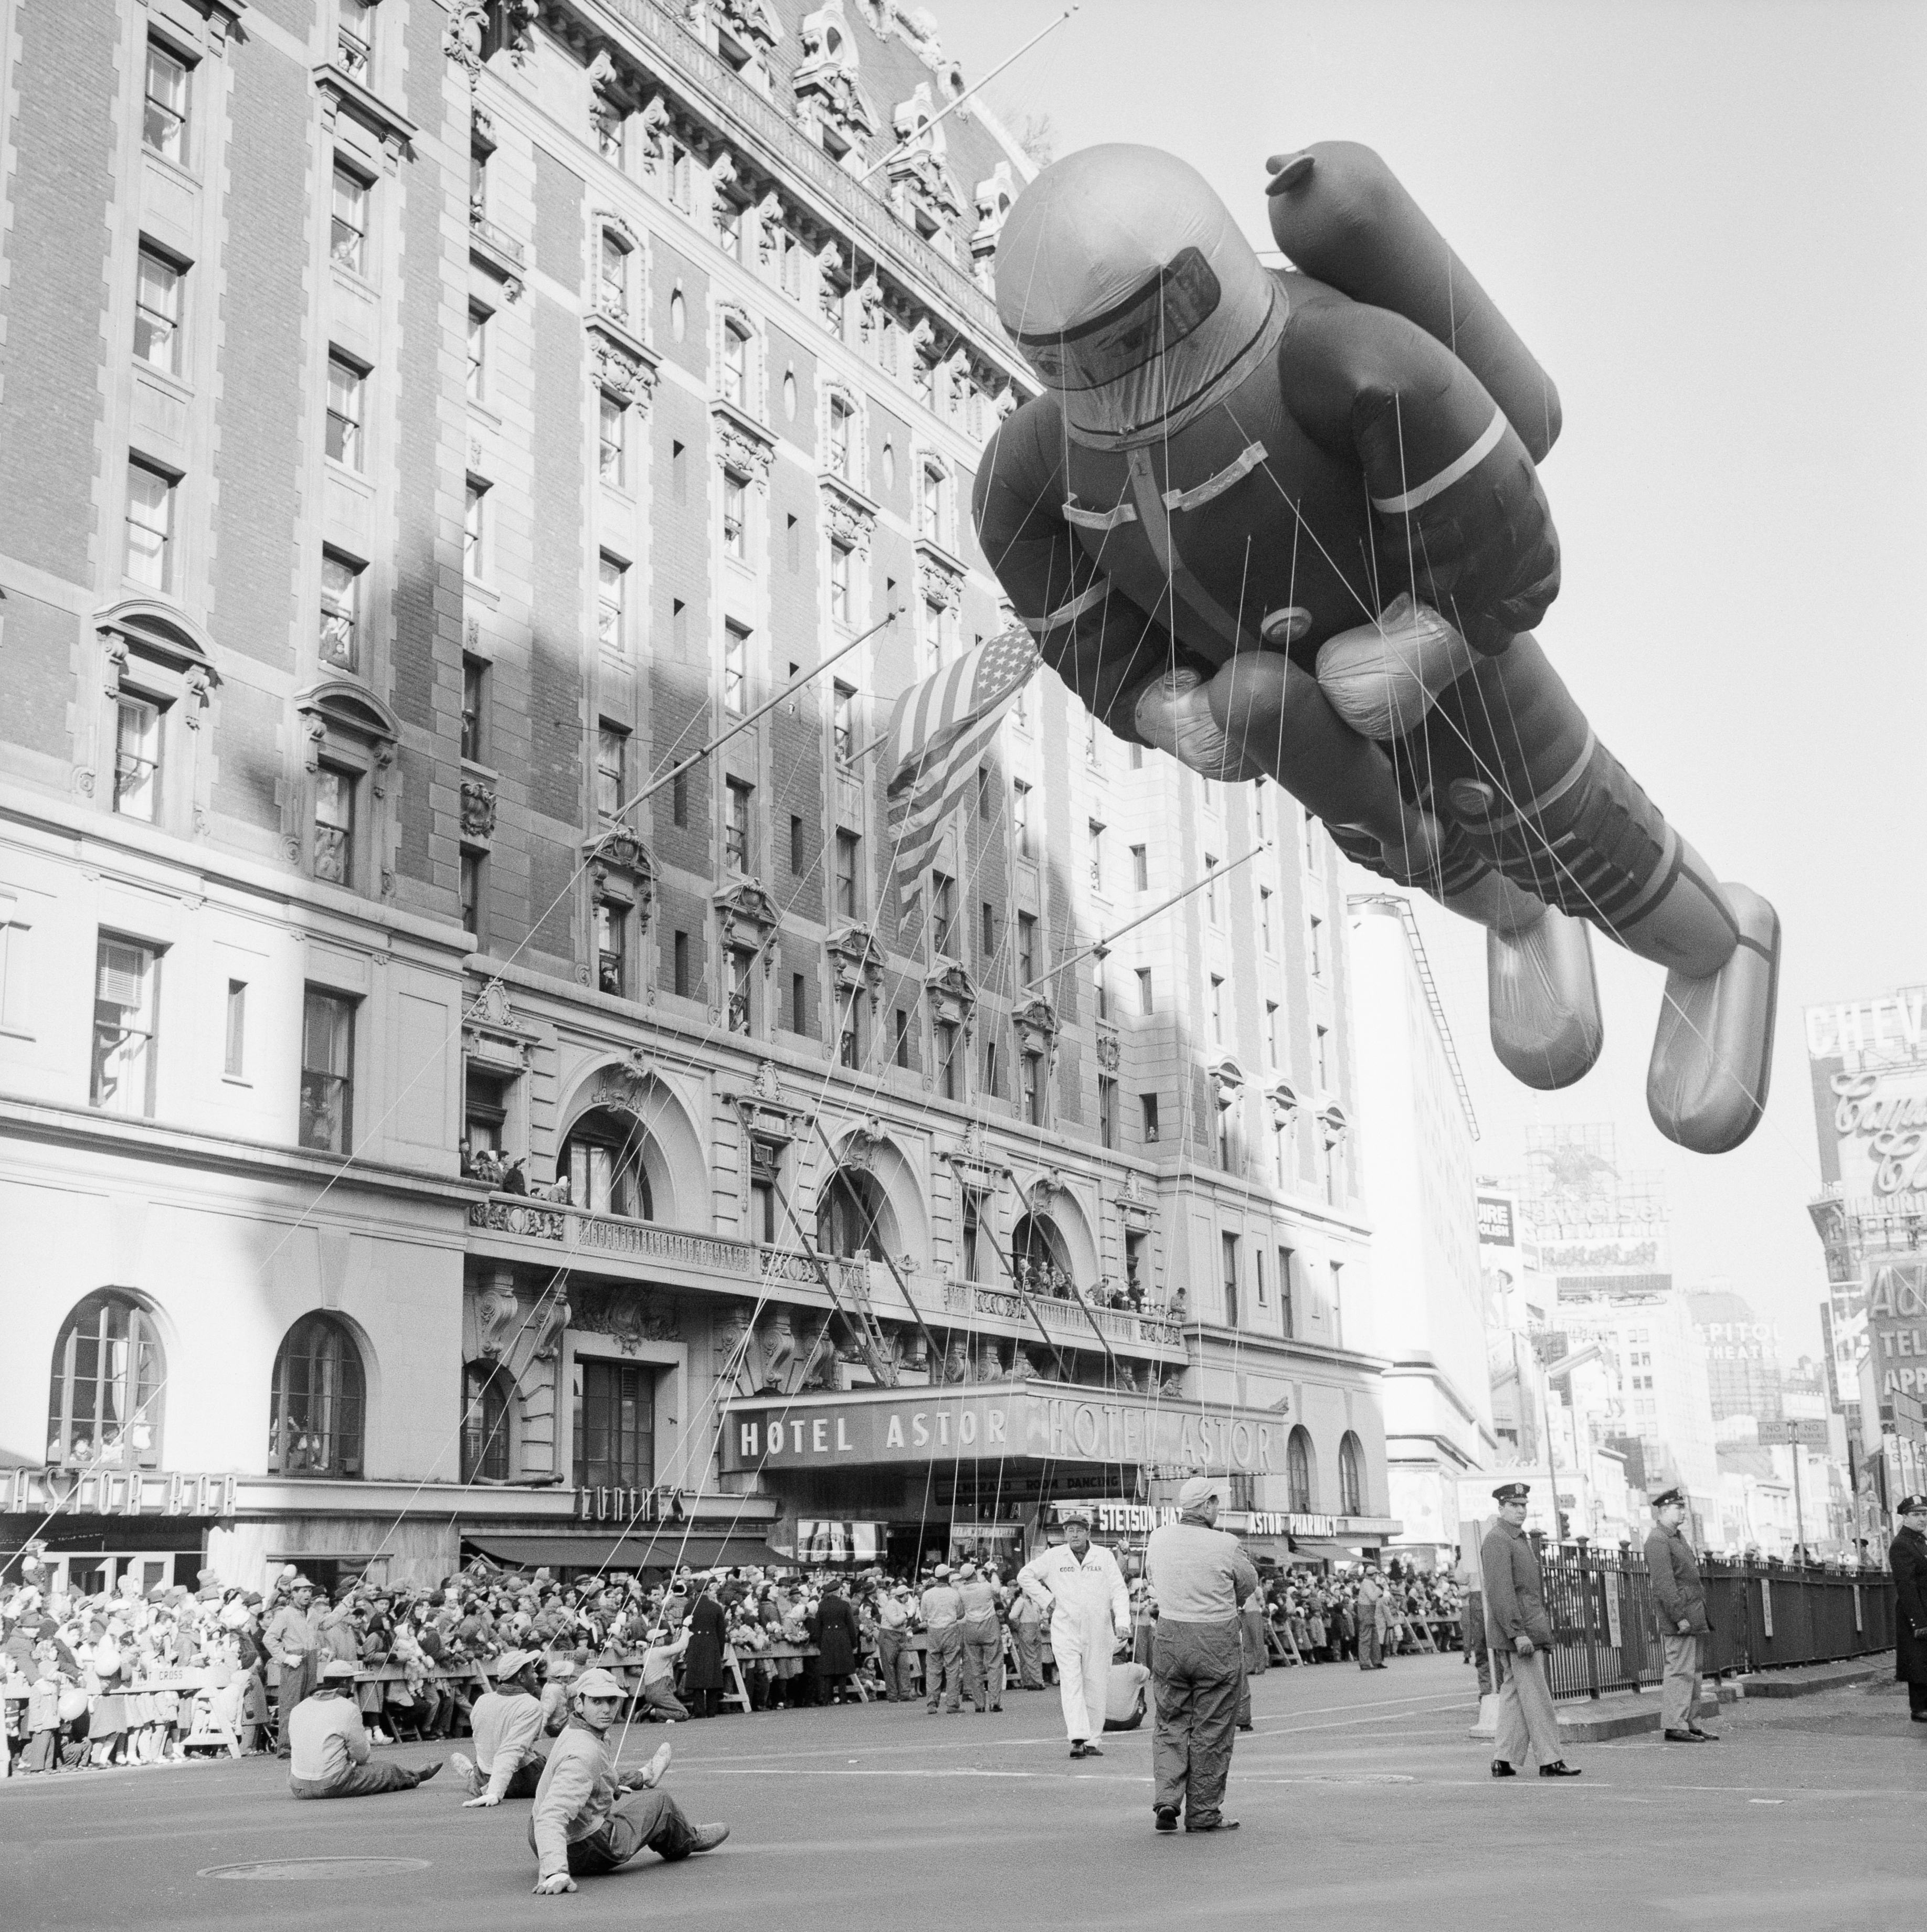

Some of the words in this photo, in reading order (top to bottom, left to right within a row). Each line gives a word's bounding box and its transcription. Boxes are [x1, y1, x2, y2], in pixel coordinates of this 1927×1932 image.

[1806, 994, 1923, 1055] CHEV
[1478, 1223, 1510, 1237] OLISH
[1705, 1345, 1783, 1360] THEATRE
[741, 1417, 853, 1456] HOTEL
[886, 1409, 1005, 1448] ASTOR
[1048, 1399, 1156, 1462] HOTEL
[1181, 1414, 1270, 1470] ASTOR
[12, 1467, 142, 1515] ASTOR
[168, 1472, 237, 1516] BAR
[955, 1481, 1011, 1493] EMERALD
[1027, 1479, 1058, 1491] ROOM
[1067, 1475, 1118, 1489] DANCING
[1099, 1504, 1157, 1532] STETSON
[1250, 1512, 1282, 1535] ASTOR
[1290, 1513, 1337, 1536] PHARMACY
[137, 1671, 152, 1682] NT
[159, 1670, 183, 1681] CROSS
